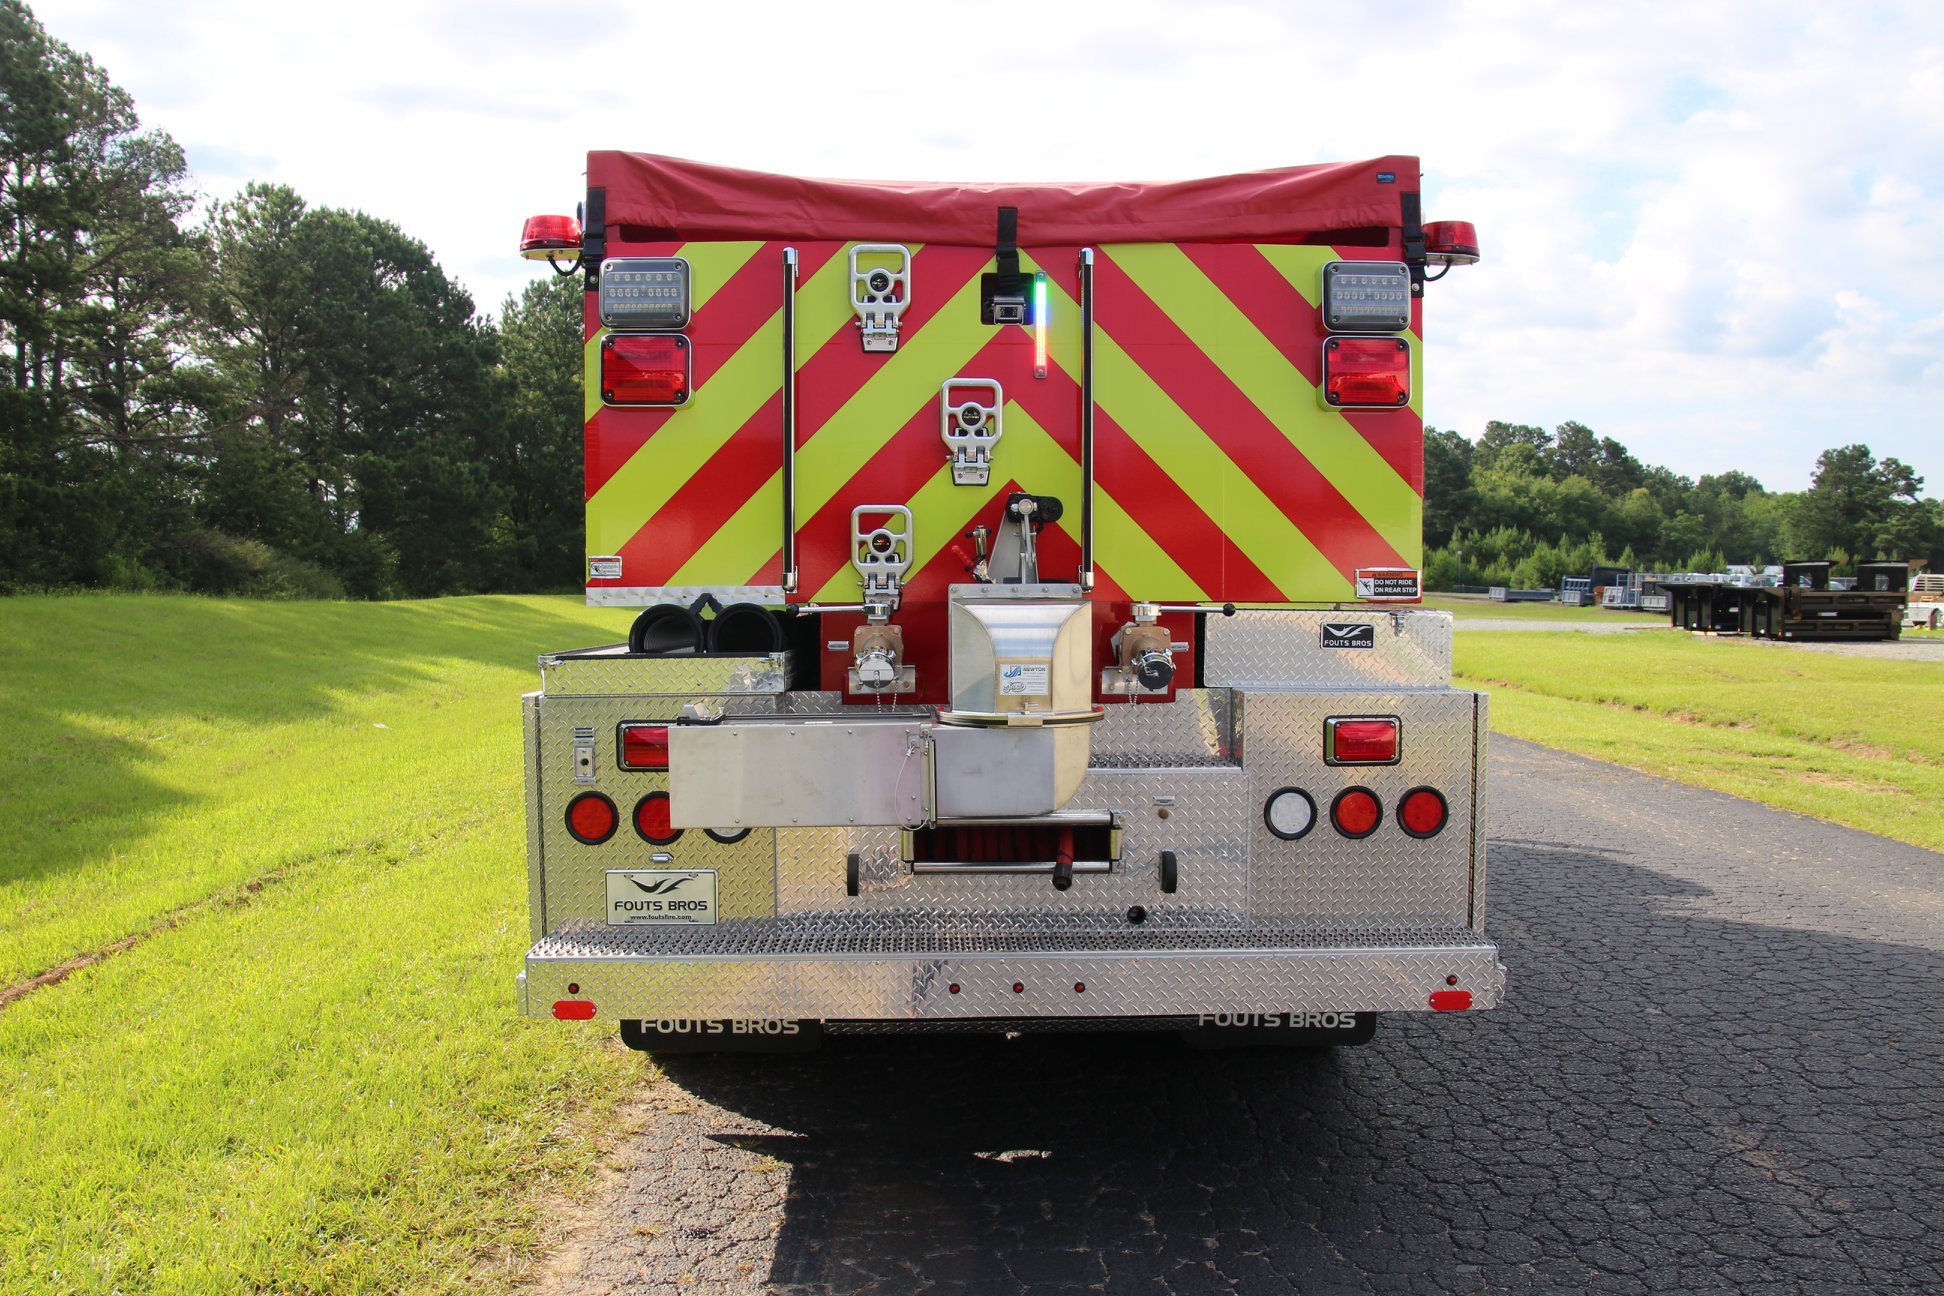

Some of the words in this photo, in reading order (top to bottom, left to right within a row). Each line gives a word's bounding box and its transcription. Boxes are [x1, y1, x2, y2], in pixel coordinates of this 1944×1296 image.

[614, 900, 663, 911] FOUTS
[668, 900, 708, 911] BROS
[640, 1019, 724, 1034] FOUTS
[732, 1019, 800, 1034] BROS
[1198, 1012, 1281, 1027] FOUTS
[1289, 1012, 1356, 1028] BROS
